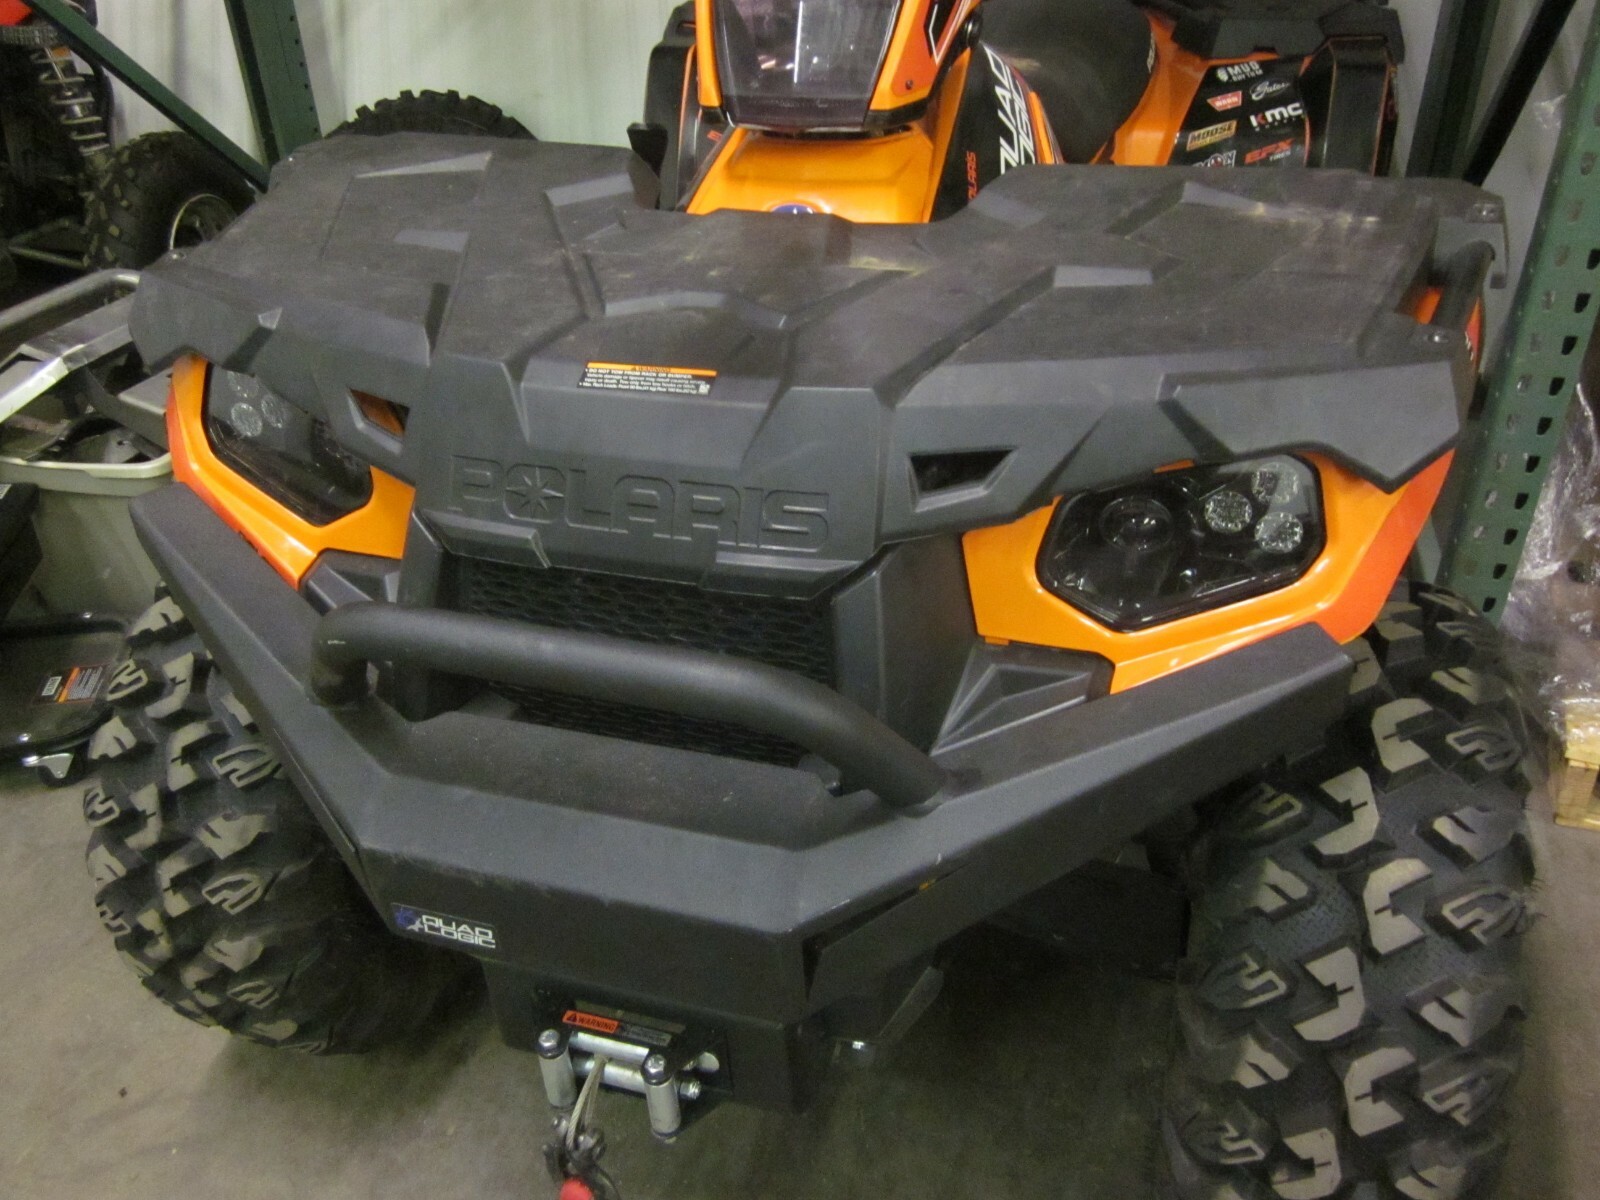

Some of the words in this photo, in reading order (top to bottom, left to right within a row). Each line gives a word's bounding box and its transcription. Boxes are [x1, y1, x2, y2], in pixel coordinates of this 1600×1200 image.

[966, 151, 977, 200] OLARIS
[446, 454, 831, 553] POLARIS
[422, 914, 493, 940] QUAD
[424, 922, 496, 949] LOGIC
[577, 1016, 617, 1032] WARNING
